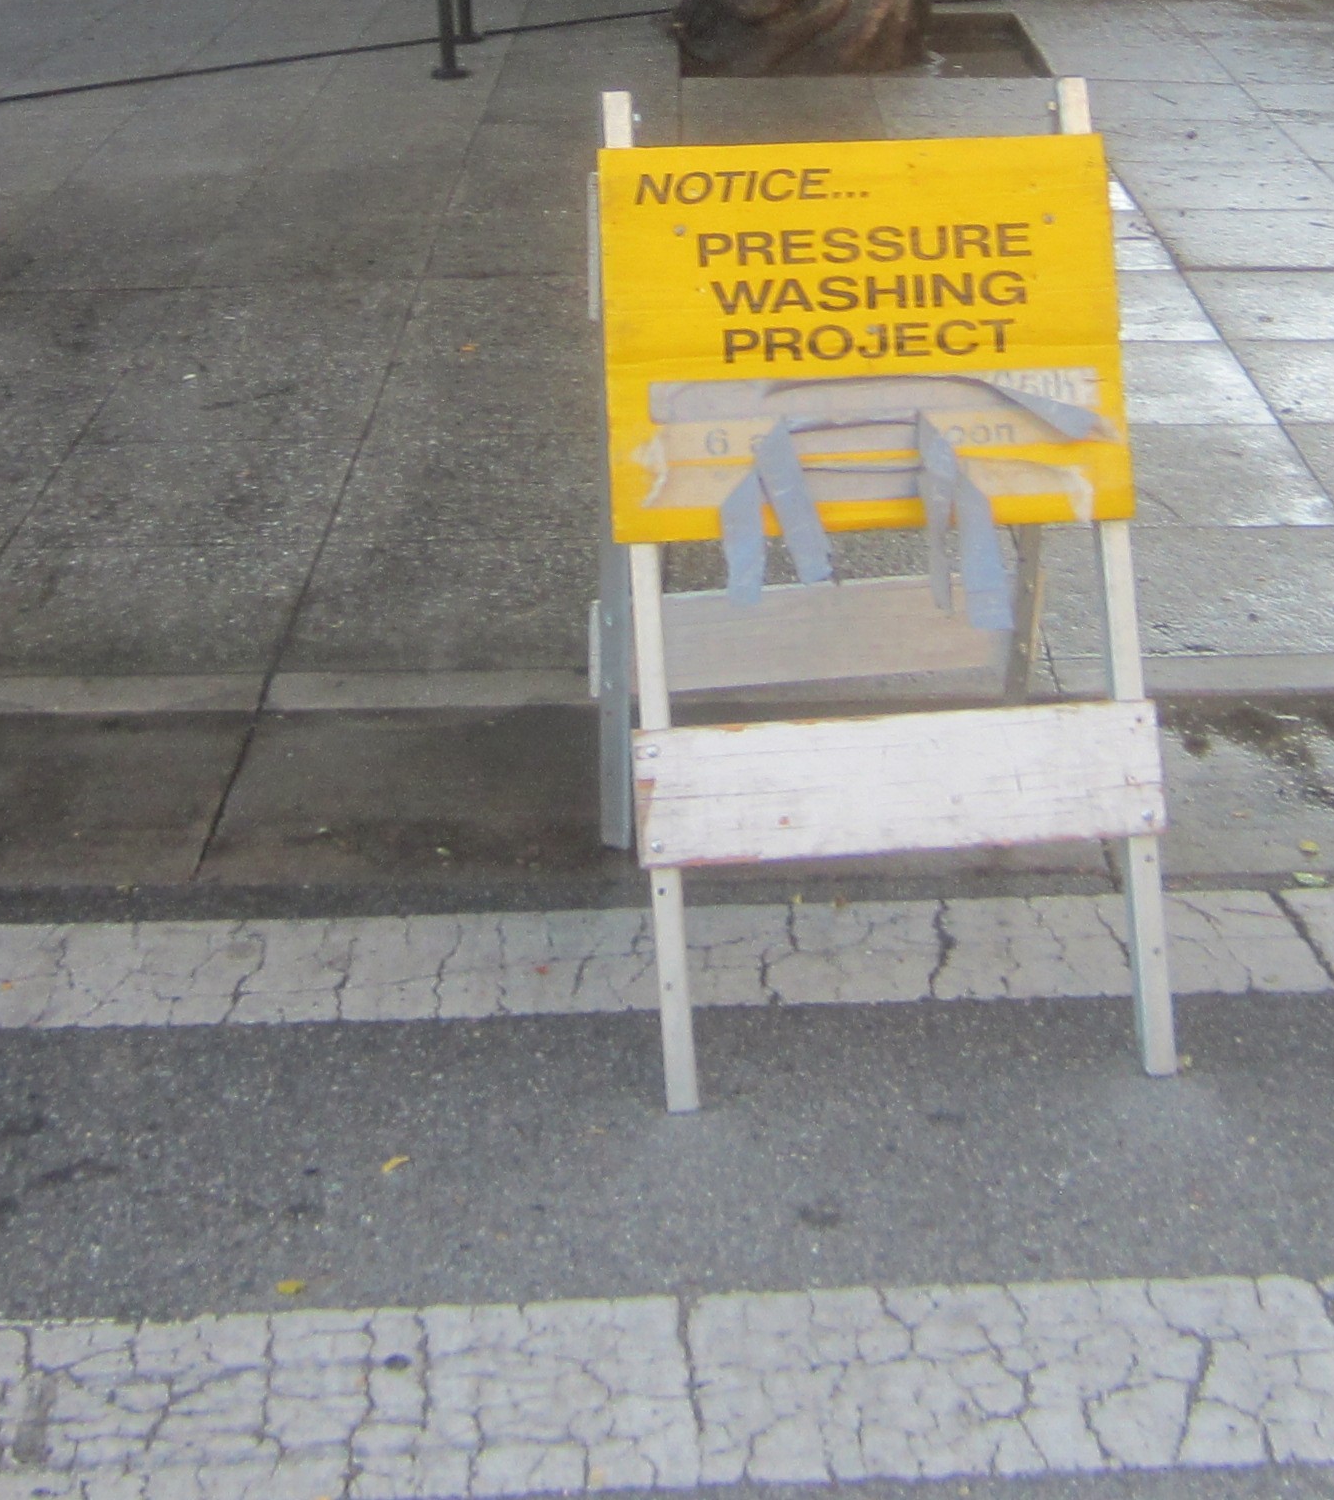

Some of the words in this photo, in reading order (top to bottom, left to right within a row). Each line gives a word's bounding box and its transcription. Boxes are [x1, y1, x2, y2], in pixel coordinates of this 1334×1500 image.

[634, 167, 871, 206] NOTICE...
[696, 222, 1034, 268] PRESSURE
[710, 270, 1027, 316] WASHING
[722, 318, 1016, 364] PROJECT
[704, 428, 729, 455] 6
